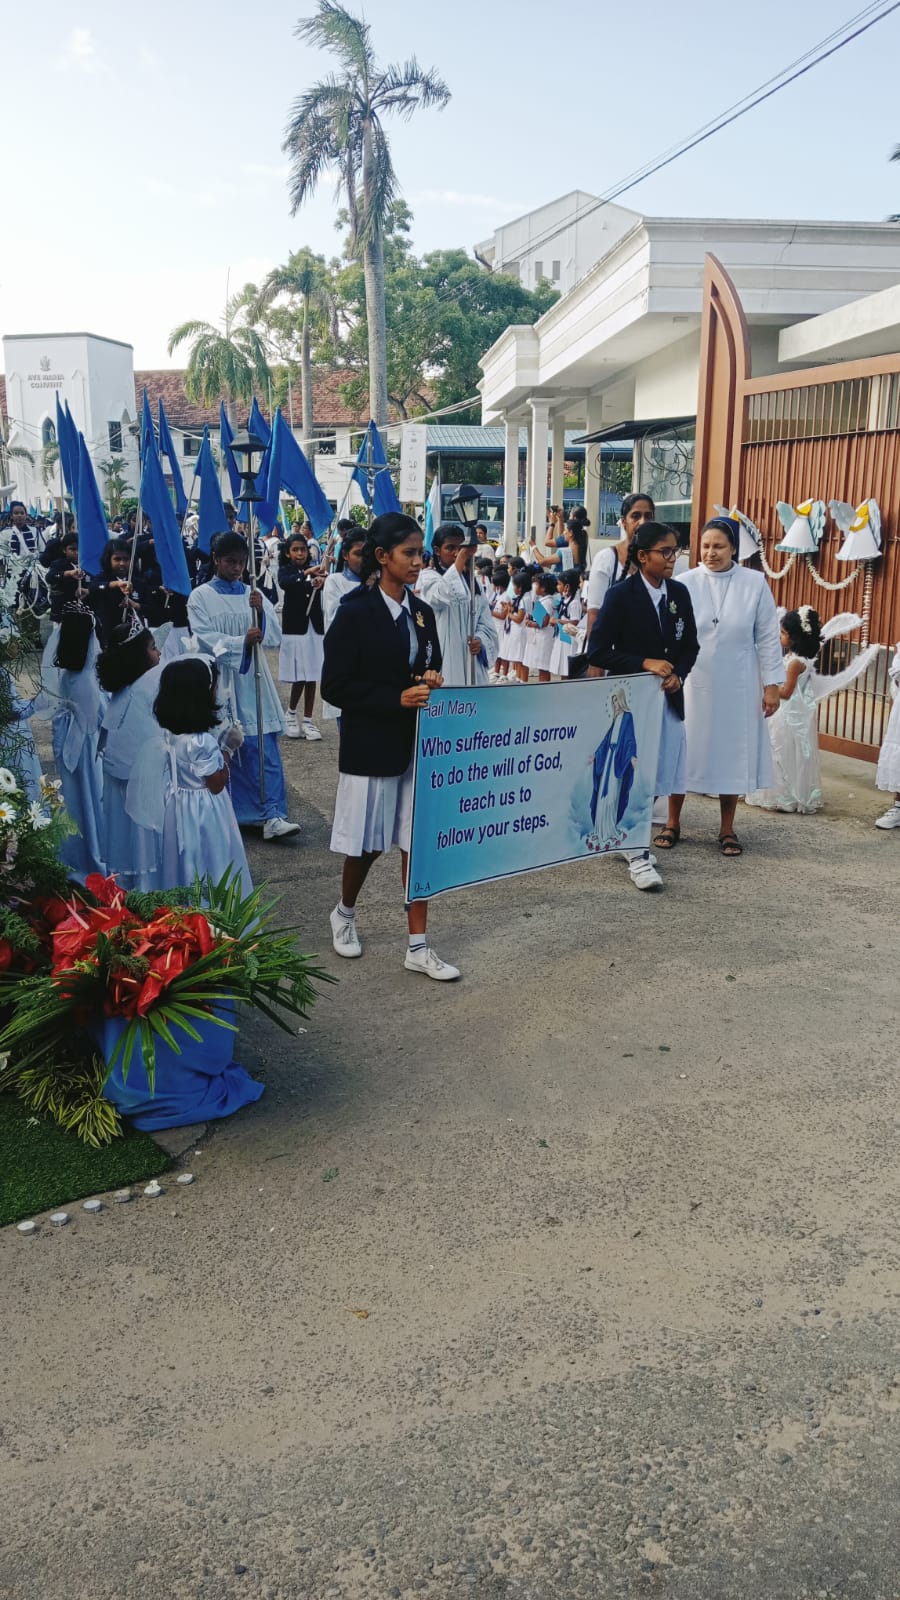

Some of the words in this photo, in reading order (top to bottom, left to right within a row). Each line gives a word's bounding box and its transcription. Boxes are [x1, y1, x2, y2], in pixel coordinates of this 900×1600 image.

[447, 699, 477, 717] Mary,
[421, 738, 452, 758] Who
[455, 728, 511, 752] suffered
[514, 726, 530, 745] all
[533, 724, 577, 743] sorrow
[430, 770, 444, 789] to
[447, 767, 464, 785] do
[467, 762, 489, 781] the
[492, 757, 515, 777] will
[517, 755, 532, 773] of
[534, 751, 563, 772] God,
[459, 790, 496, 813] teach
[499, 792, 516, 806] us
[519, 786, 532, 803] to
[437, 825, 474, 850] follow
[477, 820, 510, 845] your
[512, 813, 550, 836] steps.
